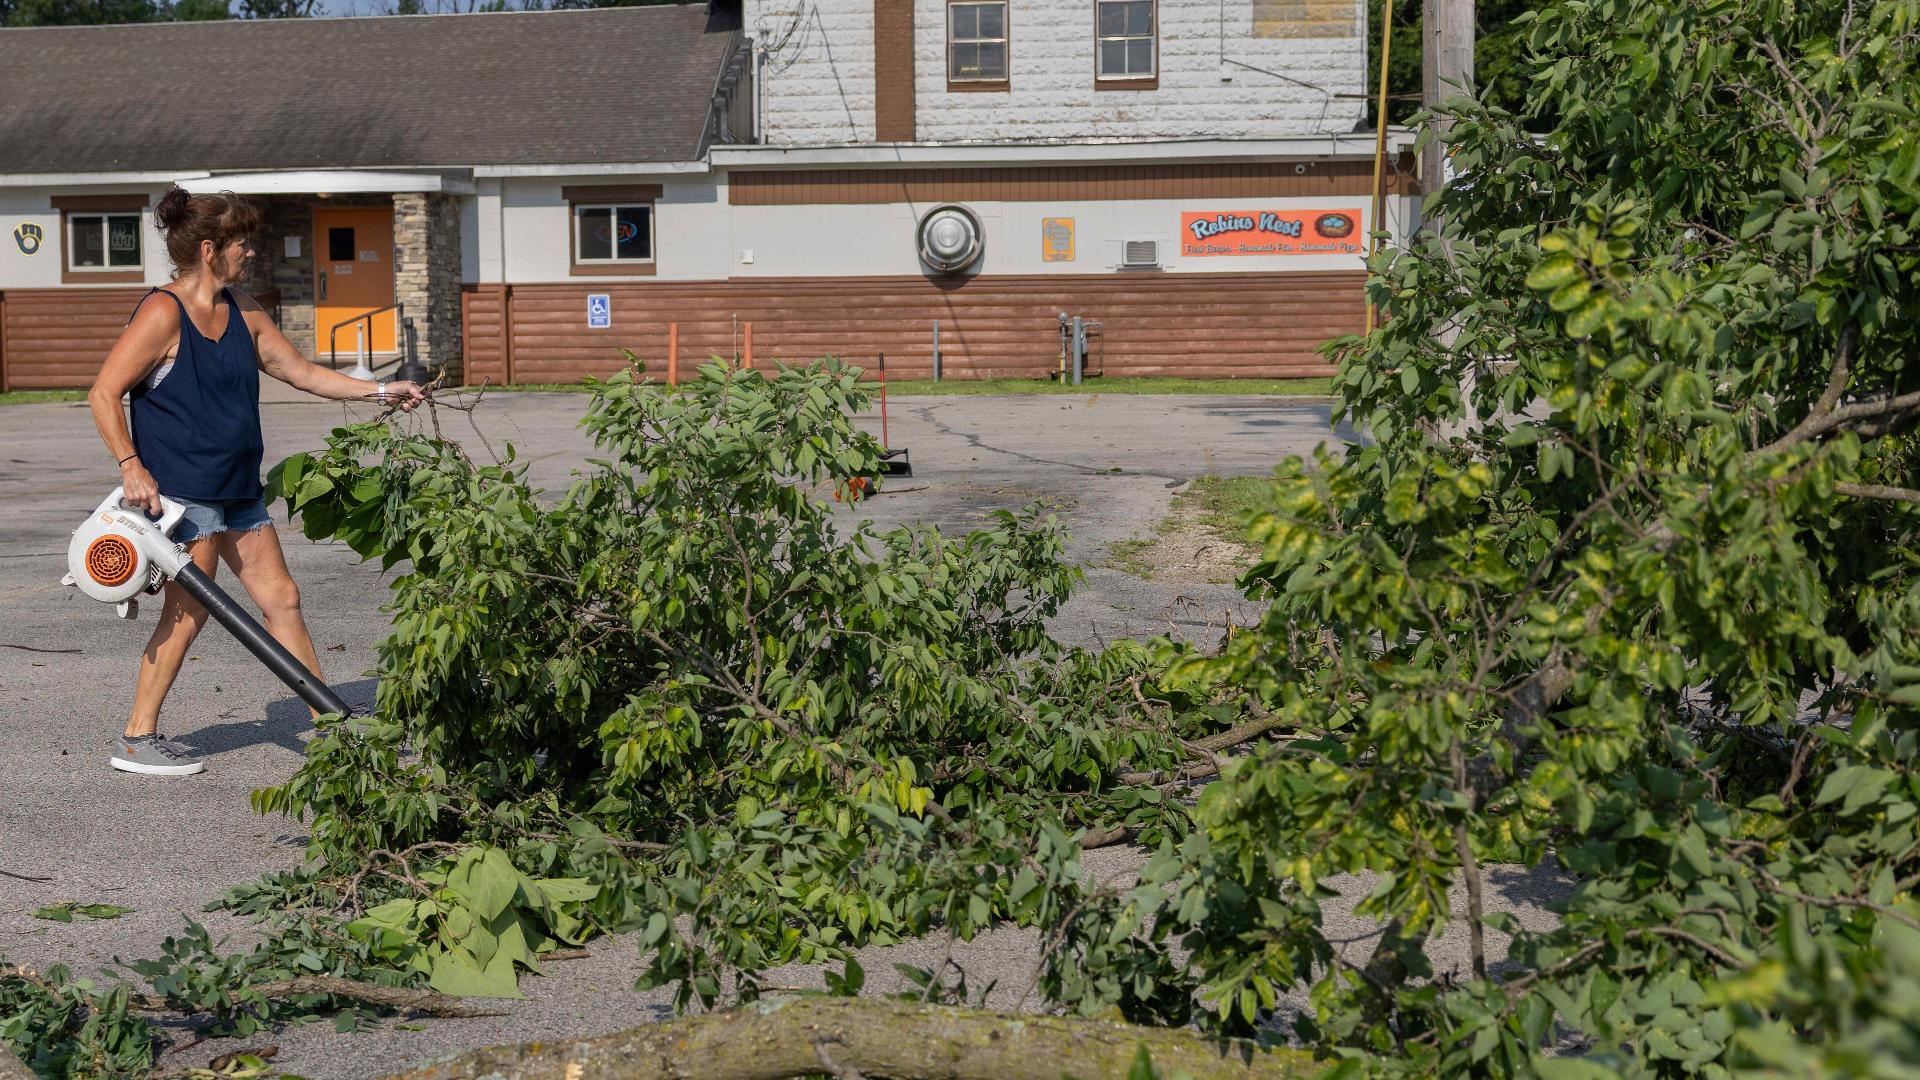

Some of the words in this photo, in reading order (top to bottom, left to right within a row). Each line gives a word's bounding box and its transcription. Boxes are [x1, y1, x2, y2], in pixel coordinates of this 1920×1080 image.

[1190, 213, 1254, 240] Robins
[1258, 212, 1302, 238] Nest
[116, 515, 145, 535] STIHL
